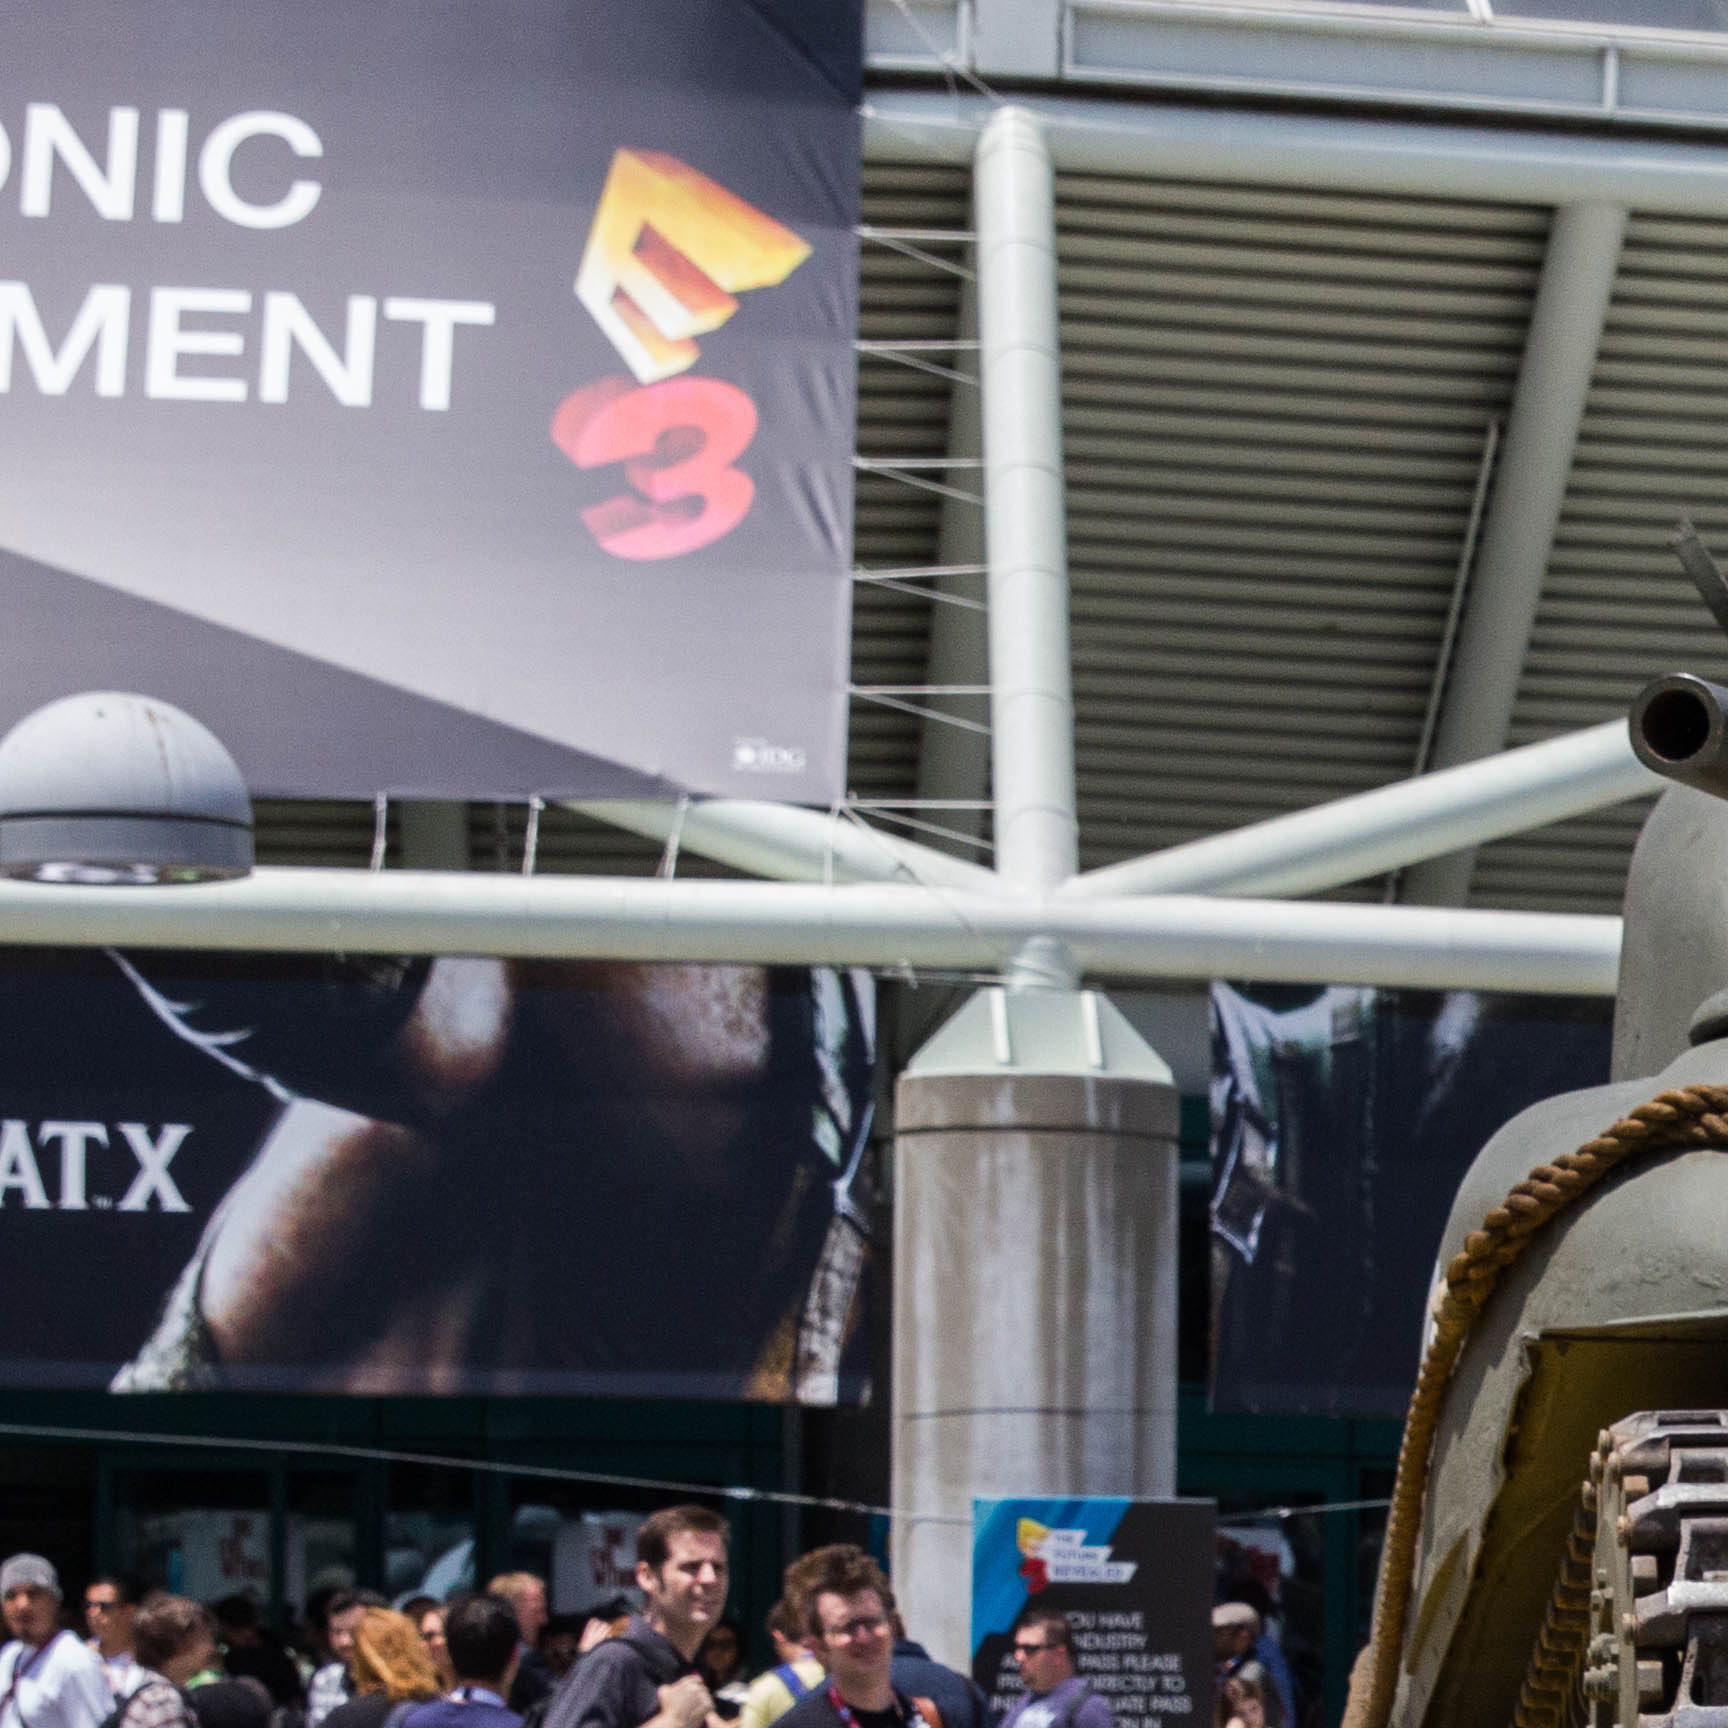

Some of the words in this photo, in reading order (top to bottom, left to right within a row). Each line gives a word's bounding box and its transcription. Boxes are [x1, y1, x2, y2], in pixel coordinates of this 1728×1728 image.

[0, 103, 324, 230] NIC
[0, 281, 495, 411] MENT
[0, 1118, 194, 1213] ATX
[1071, 1633, 1148, 1650] NDUSTRY
